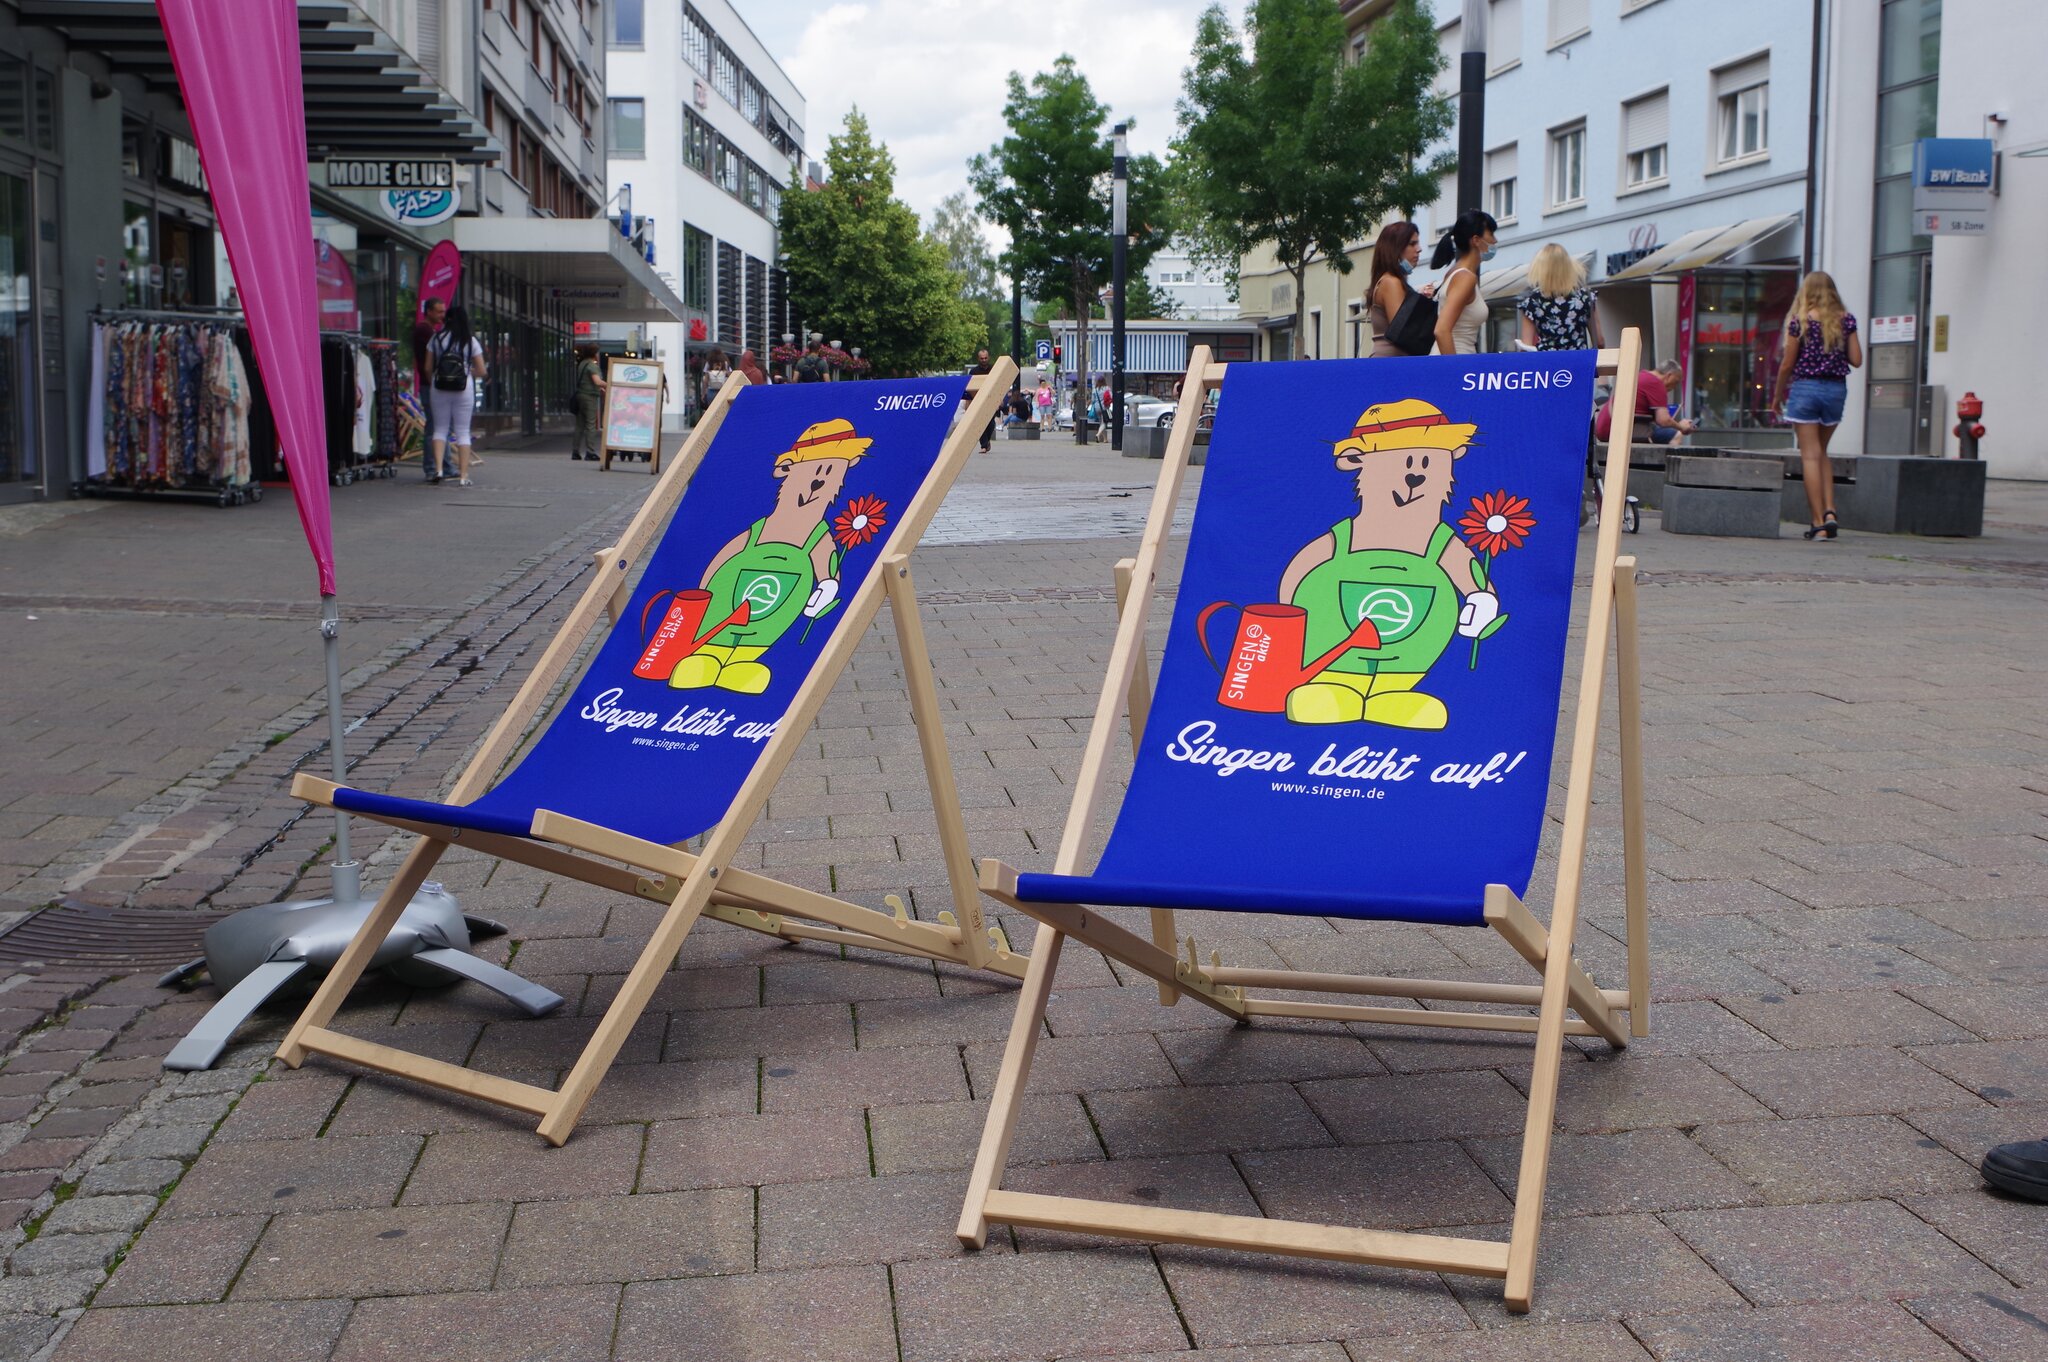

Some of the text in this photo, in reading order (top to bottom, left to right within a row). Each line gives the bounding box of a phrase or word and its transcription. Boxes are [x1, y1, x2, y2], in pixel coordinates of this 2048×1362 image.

[329, 162, 451, 186] MODE CLUB
[1039, 346, 1048, 358] P
[1462, 370, 1549, 391] SINGEN
[873, 393, 933, 411] SINGEN
[668, 614, 684, 639] aktiv
[640, 621, 675, 671] SINGEN
[1256, 634, 1272, 662] aktiv
[1228, 641, 1259, 700] SINGEN
[580, 687, 658, 733] Singen
[660, 704, 736, 737] blüht
[631, 736, 700, 751] www.singen.de
[1165, 720, 1528, 789] Singen blüht auf!
[1271, 780, 1385, 800] www.singen.de
